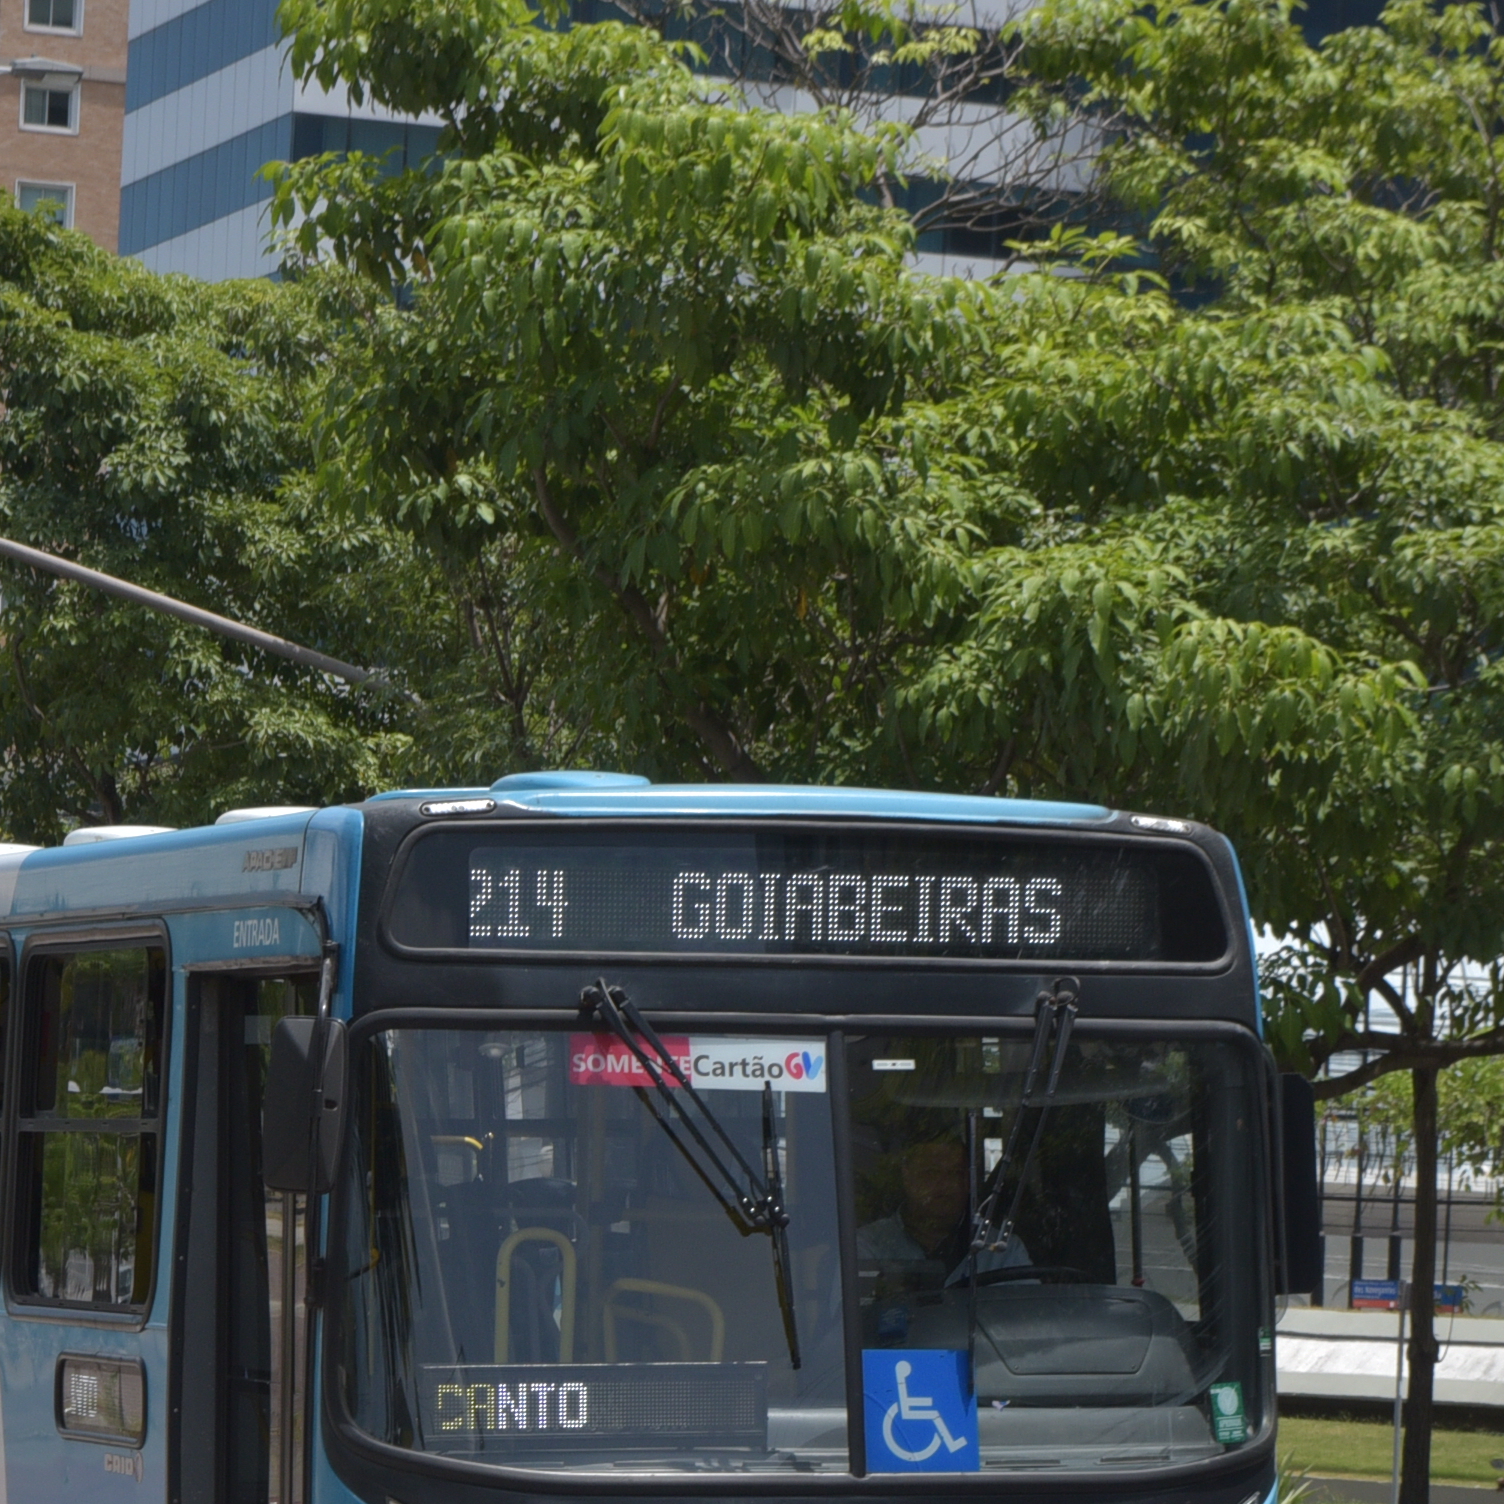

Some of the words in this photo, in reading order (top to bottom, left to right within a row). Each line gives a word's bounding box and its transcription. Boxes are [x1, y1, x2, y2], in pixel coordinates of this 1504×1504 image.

[233, 918, 280, 948] ENTRADA
[470, 869, 569, 938] 214
[670, 870, 1064, 945] GOIABEIRAS
